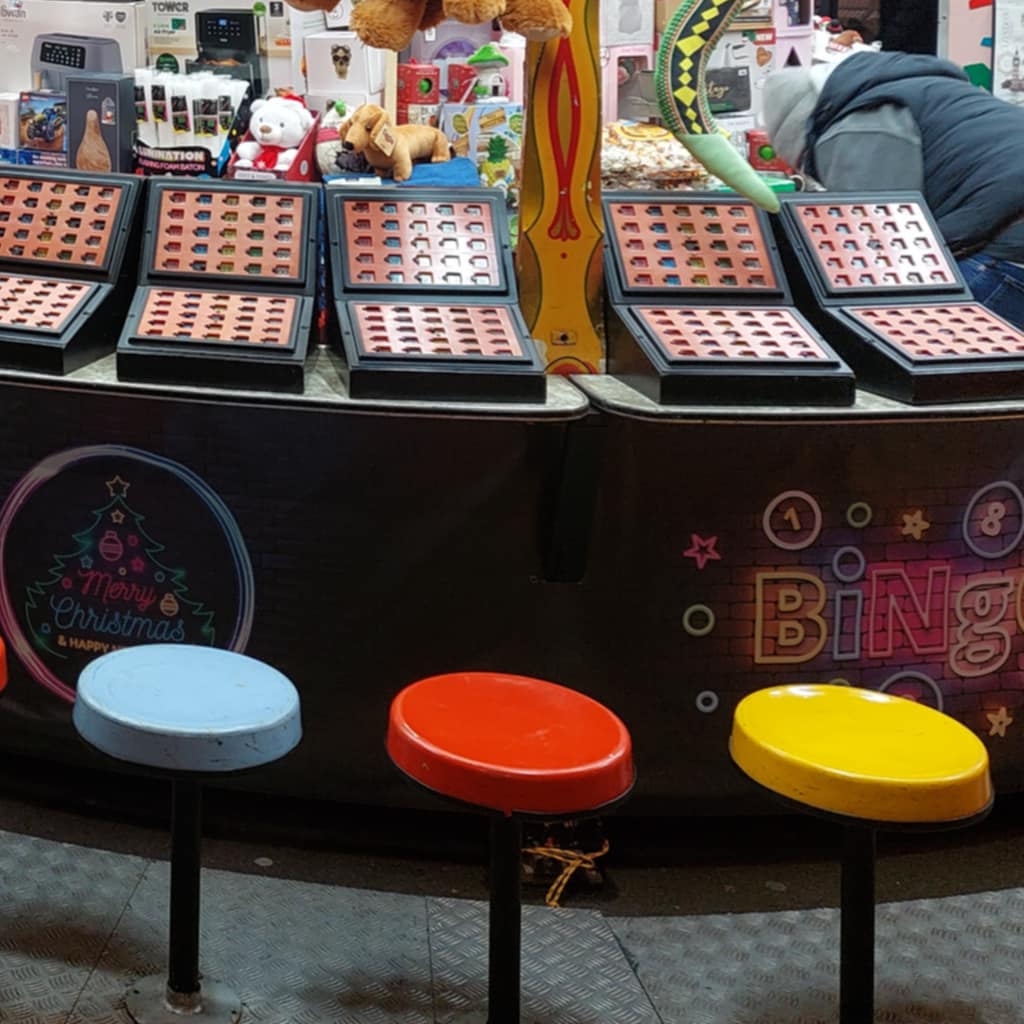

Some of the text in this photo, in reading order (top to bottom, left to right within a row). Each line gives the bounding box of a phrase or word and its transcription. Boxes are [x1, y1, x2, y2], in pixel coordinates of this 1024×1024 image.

[152, 0, 189, 13] TOWER
[980, 501, 1007, 537] 8
[77, 569, 158, 613] Merry
[49, 593, 186, 643] Christmas
[69, 636, 110, 654] HAPPY
